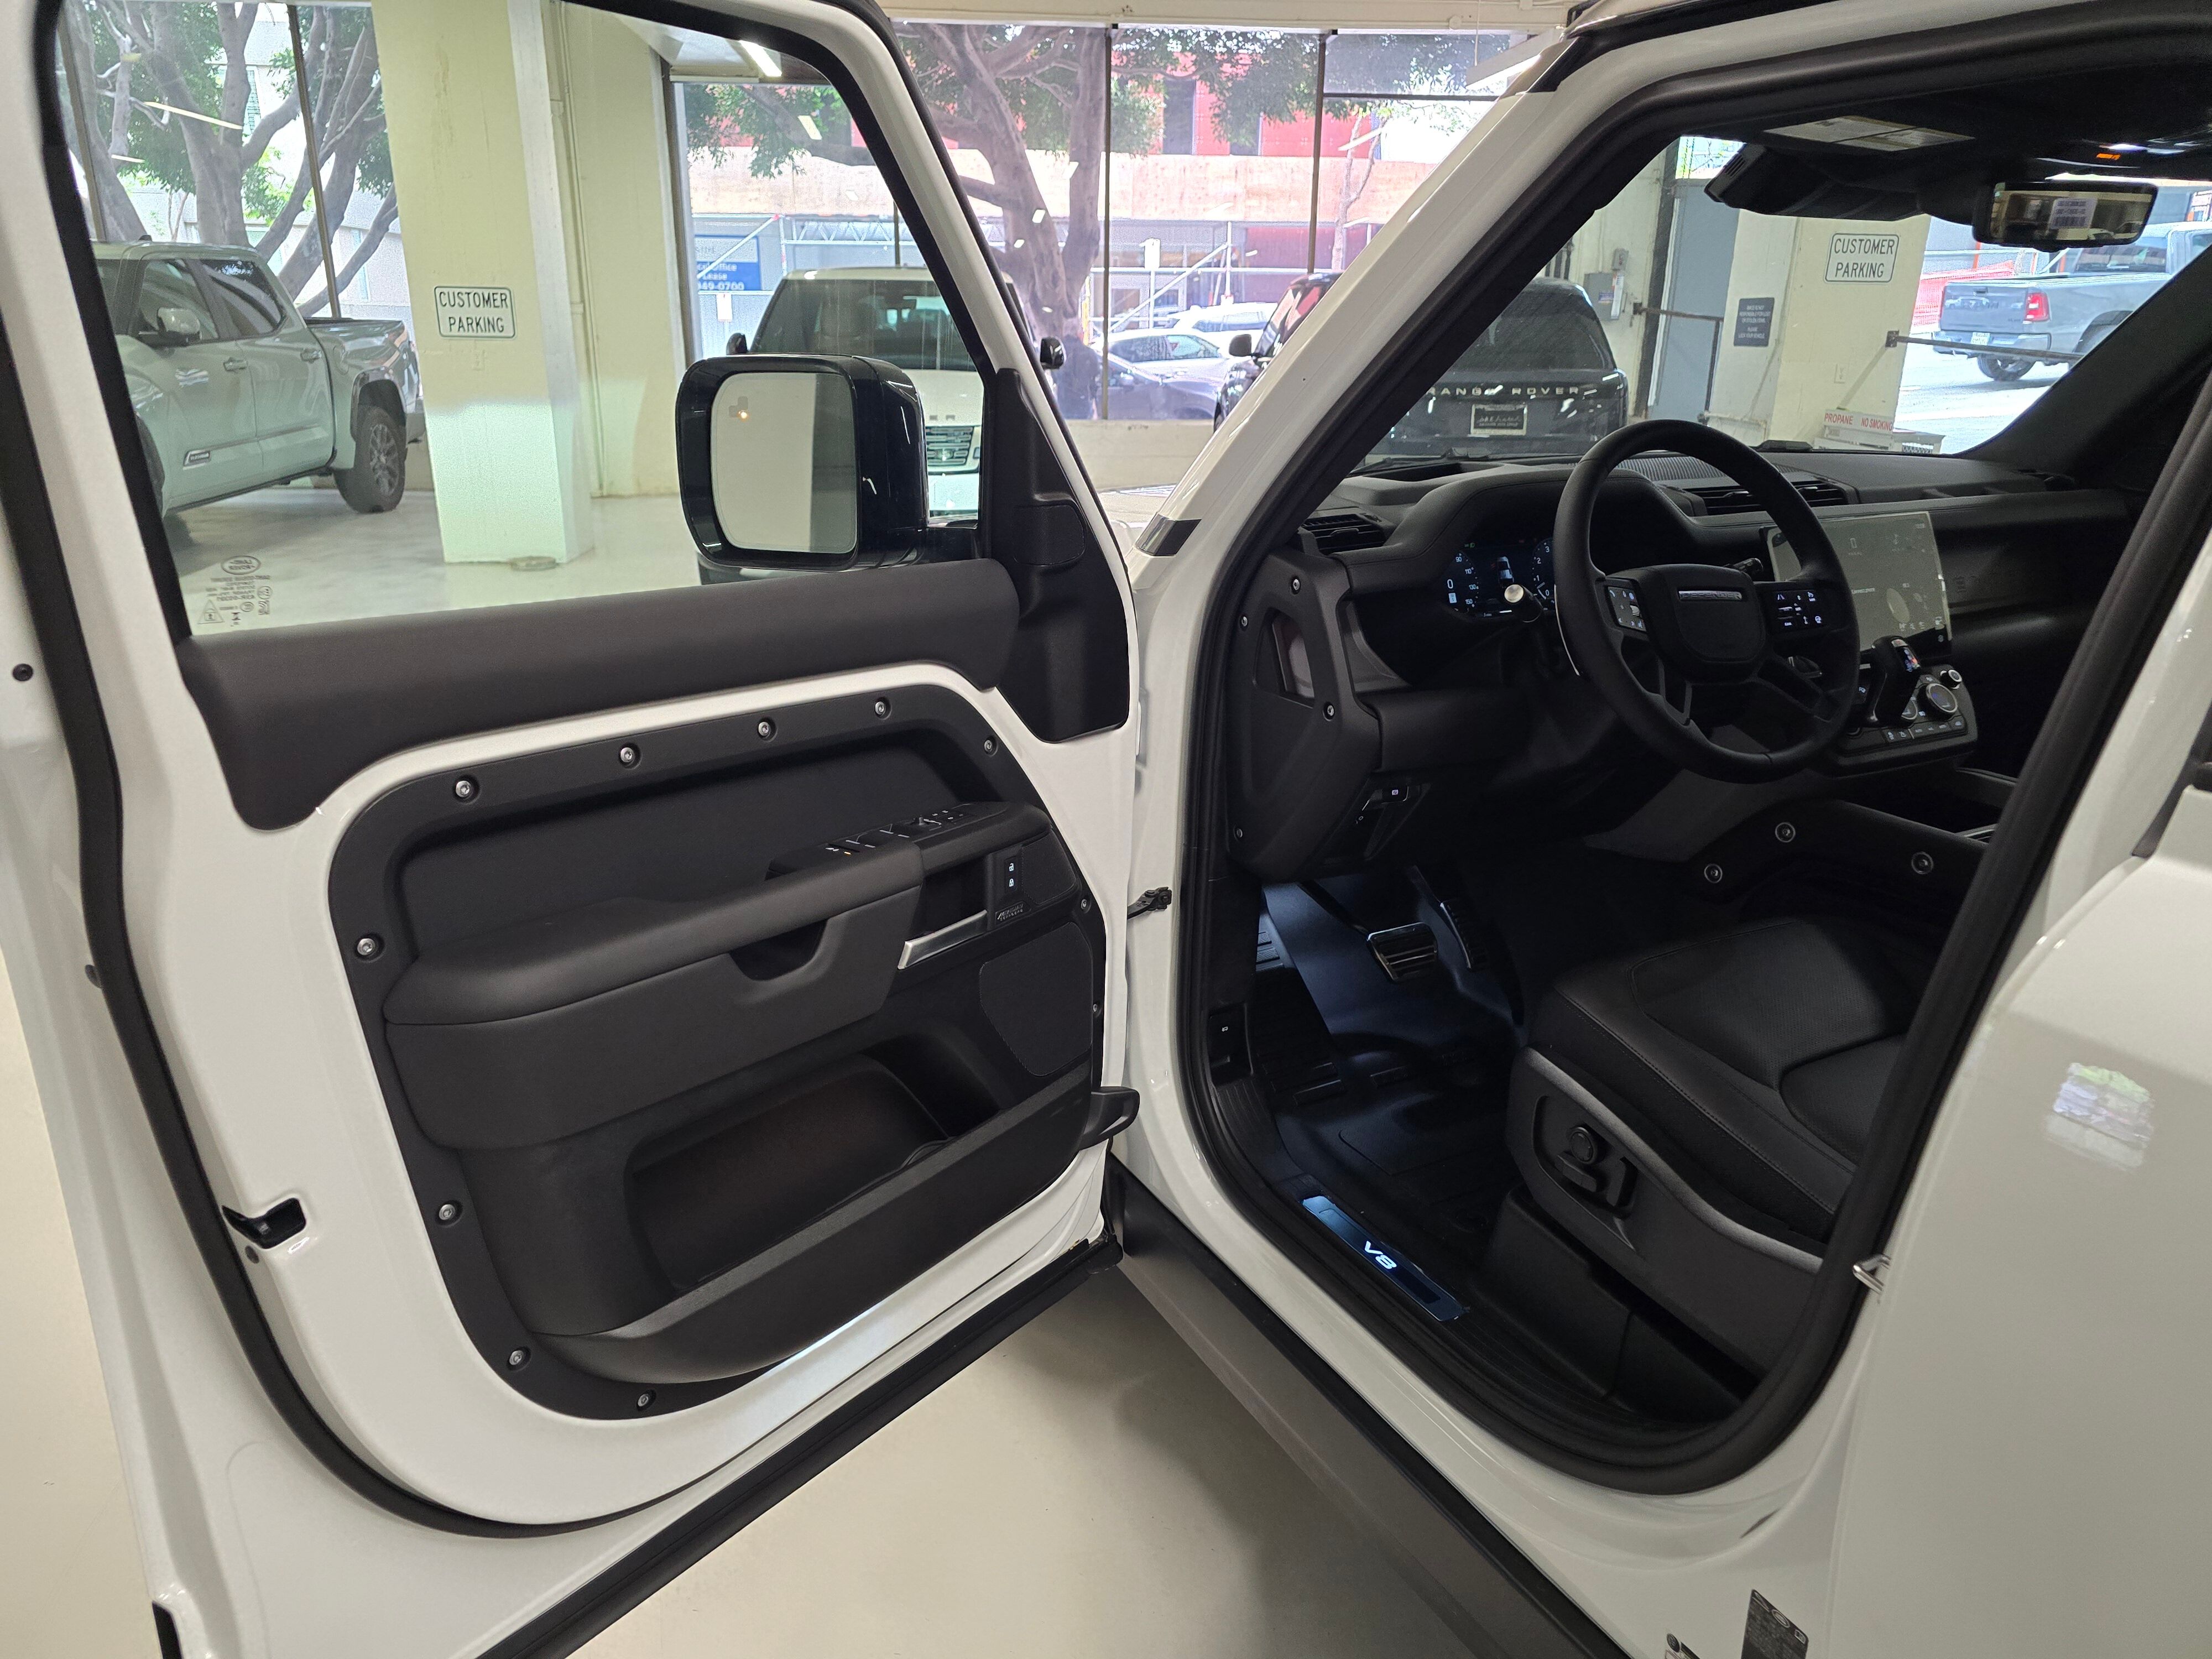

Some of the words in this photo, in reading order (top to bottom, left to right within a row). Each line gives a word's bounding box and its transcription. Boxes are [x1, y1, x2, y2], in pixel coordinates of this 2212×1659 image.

[1834, 238, 1895, 255] CUSTOMER
[1835, 262, 1885, 278] PARKING
[439, 291, 508, 309] CUSTOMER
[448, 316, 504, 333] PARKING
[1512, 387, 1579, 395] ROVER
[1824, 413, 1854, 425] PROPANE
[1861, 418, 1869, 427] NO
[1869, 419, 1892, 431] SMOKING
[1447, 579, 1453, 589] 0
[1364, 1240, 1397, 1269] V8
